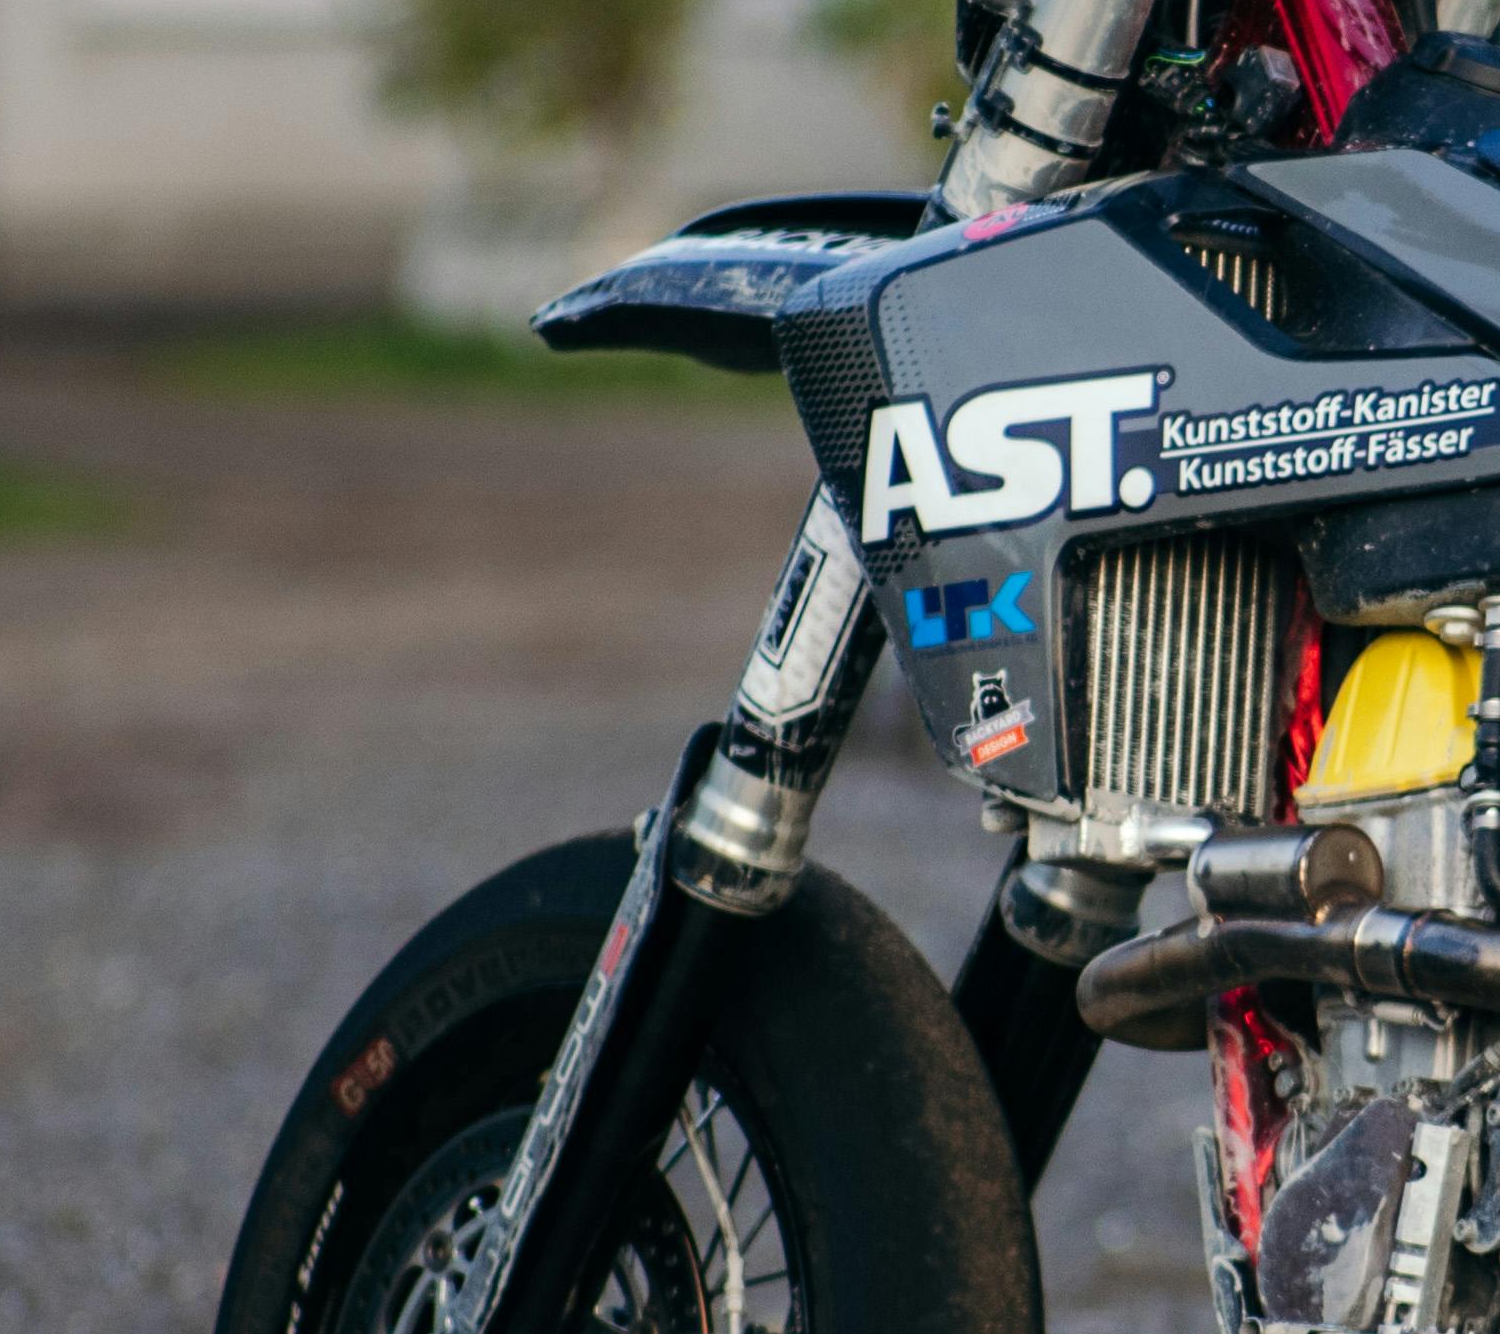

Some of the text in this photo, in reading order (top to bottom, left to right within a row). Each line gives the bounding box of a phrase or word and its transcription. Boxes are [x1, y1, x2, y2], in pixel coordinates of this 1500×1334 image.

[1161, 380, 1495, 450] Kunststoff-Kanister
[1178, 425, 1474, 491] Kunststoff-Fässer
[964, 710, 1021, 746] BACKYARD
[977, 732, 1017, 758] DESIGN
